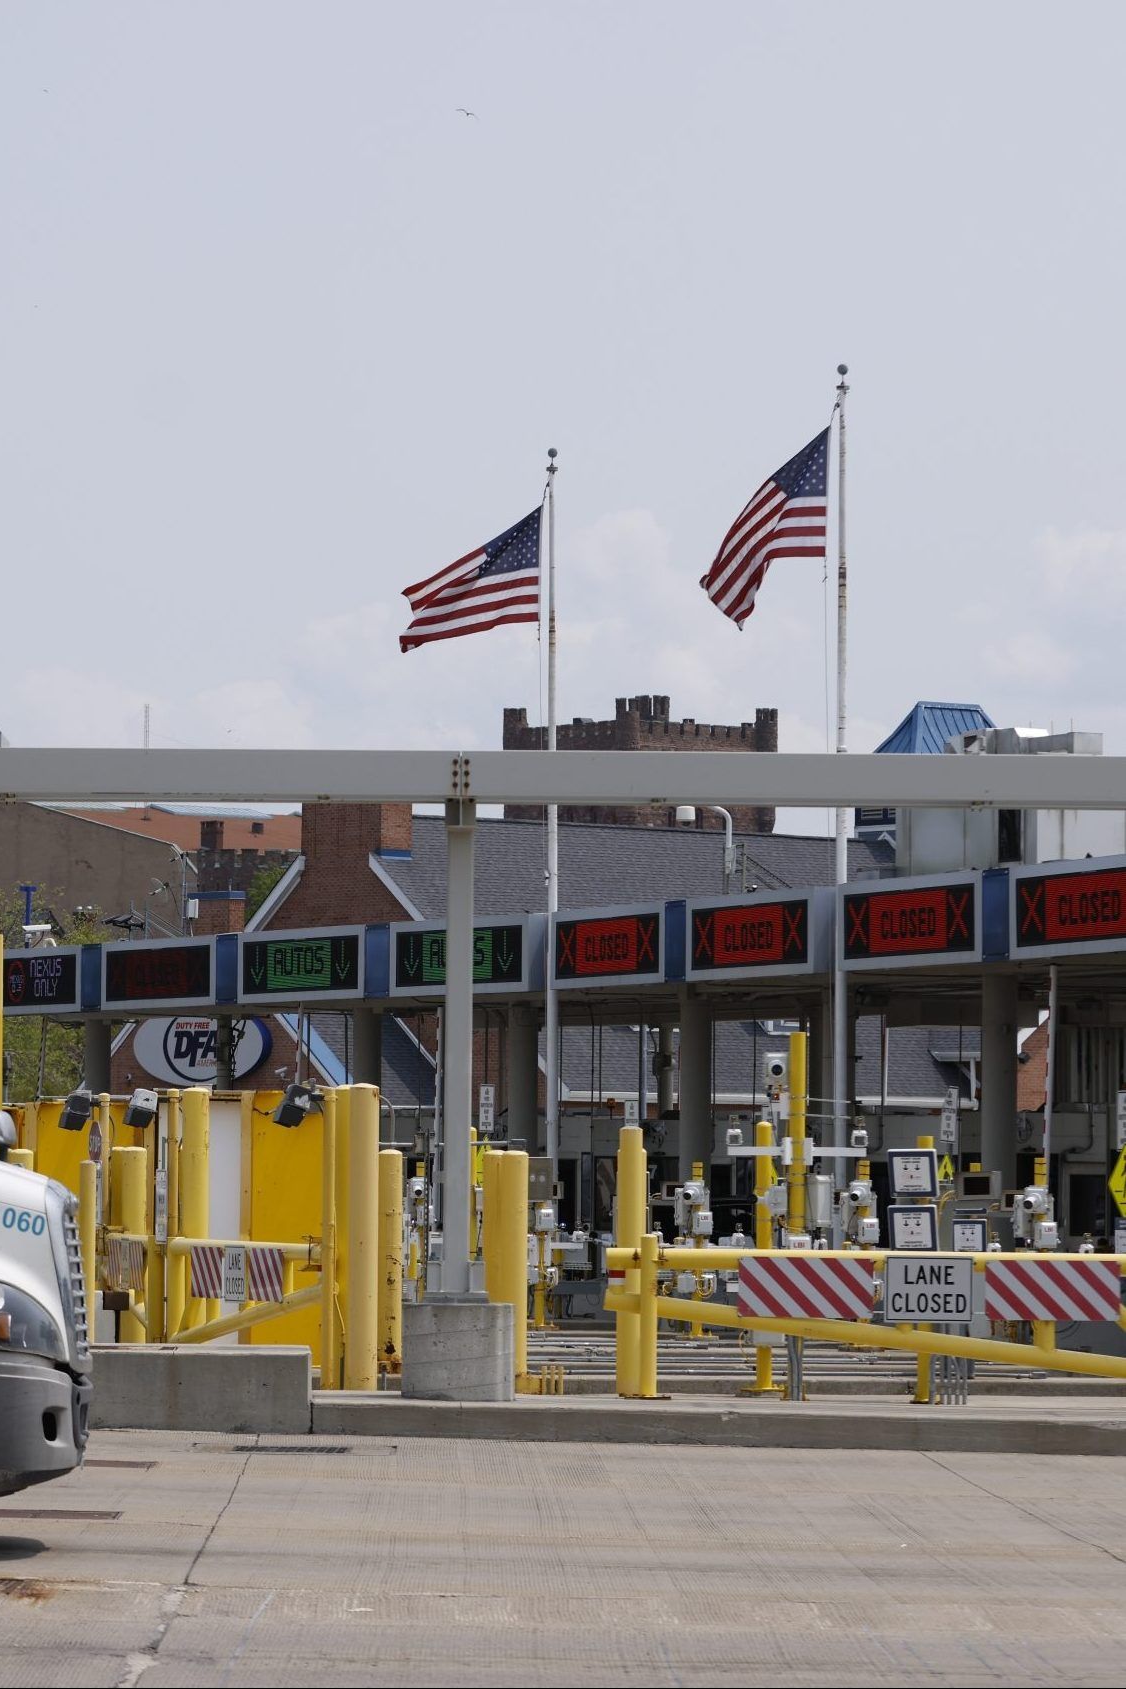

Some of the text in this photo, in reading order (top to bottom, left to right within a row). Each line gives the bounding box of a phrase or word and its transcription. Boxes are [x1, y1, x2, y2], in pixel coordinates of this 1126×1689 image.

[1057, 889, 1121, 926] CLOSED
[881, 907, 936, 940] CLOSED
[724, 921, 773, 952] CLOSED
[585, 933, 628, 962] CLOSED
[30, 958, 62, 977] NEXUS
[274, 945, 325, 976] AUTOS
[34, 978, 58, 997] ONLY
[228, 1252, 242, 1270] LANE
[904, 1264, 955, 1285] LANE
[225, 1276, 245, 1295] CLOSED
[891, 1292, 967, 1313] CLOSED
